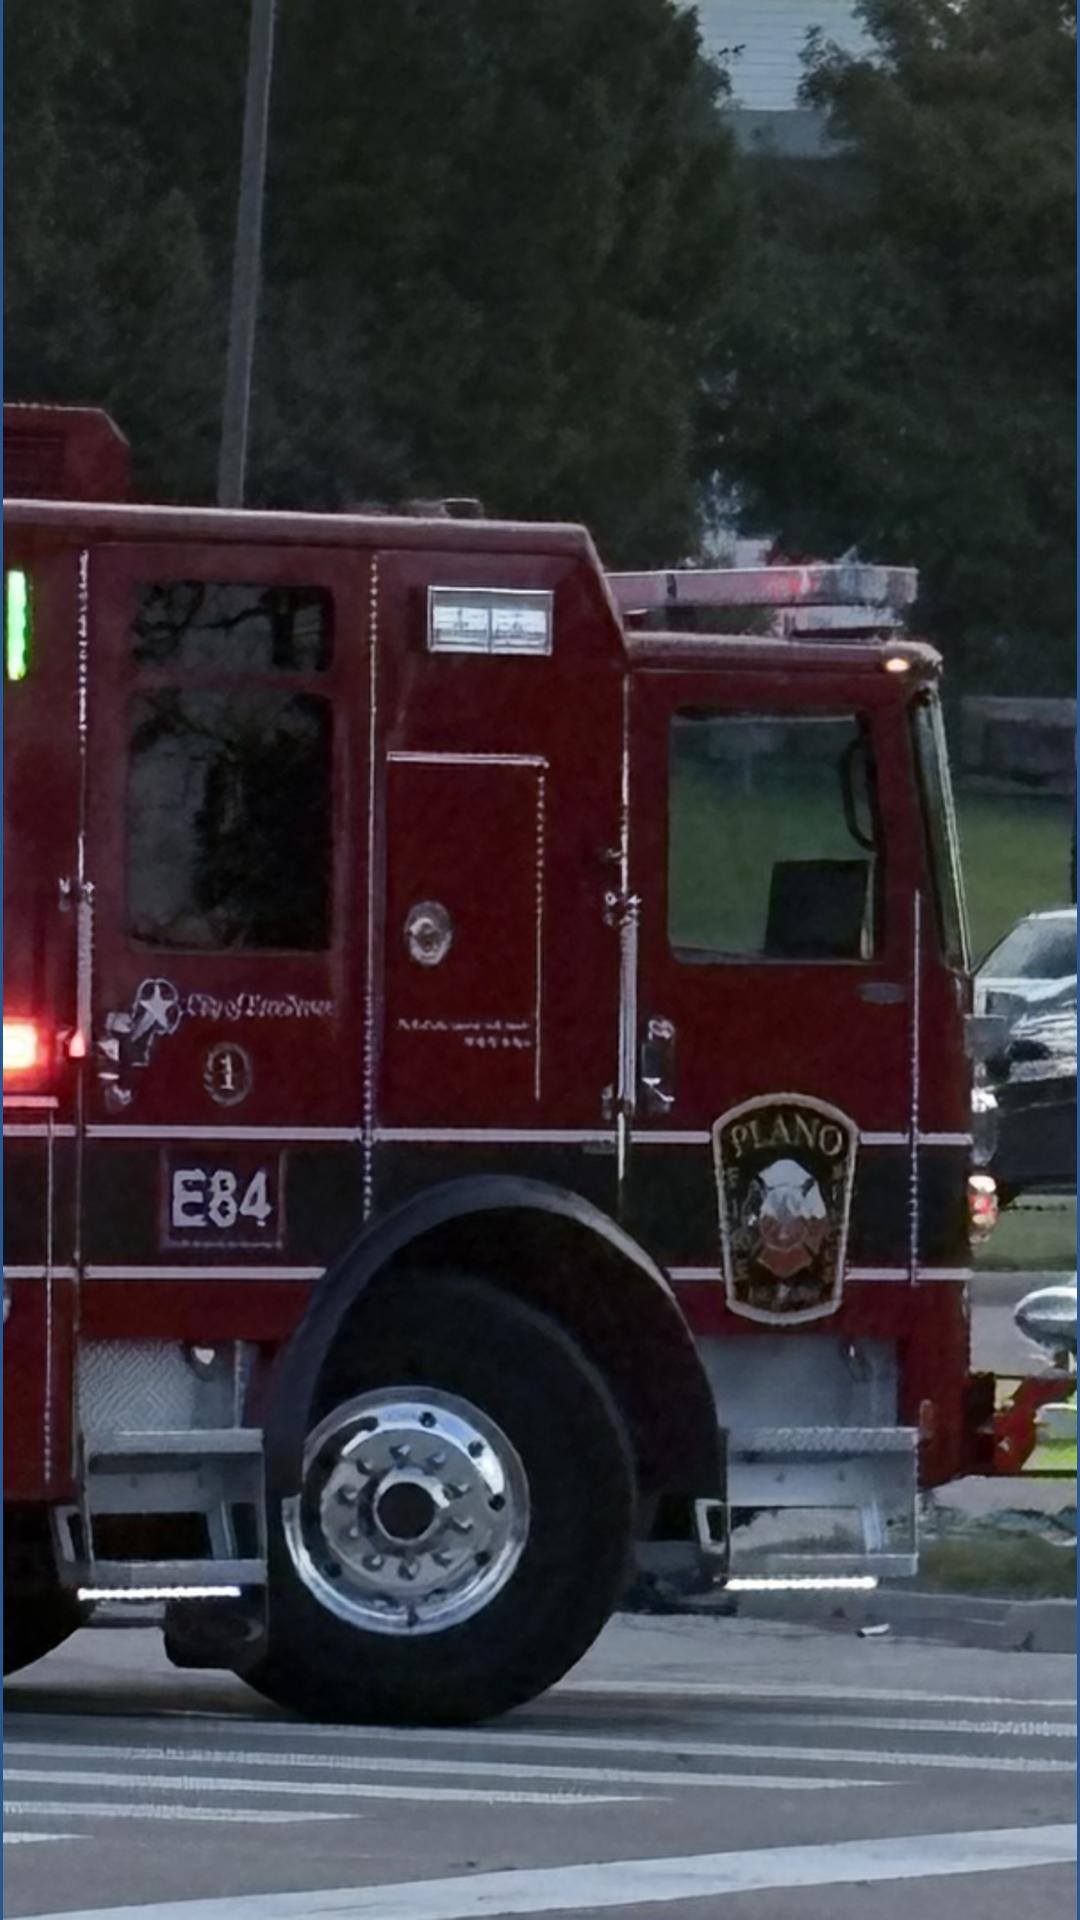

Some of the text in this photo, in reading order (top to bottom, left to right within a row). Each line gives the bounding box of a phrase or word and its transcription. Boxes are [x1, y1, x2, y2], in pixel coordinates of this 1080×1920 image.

[220, 1053, 235, 1090] 1
[730, 1113, 843, 1158] PLANO
[172, 1167, 272, 1228] E84
